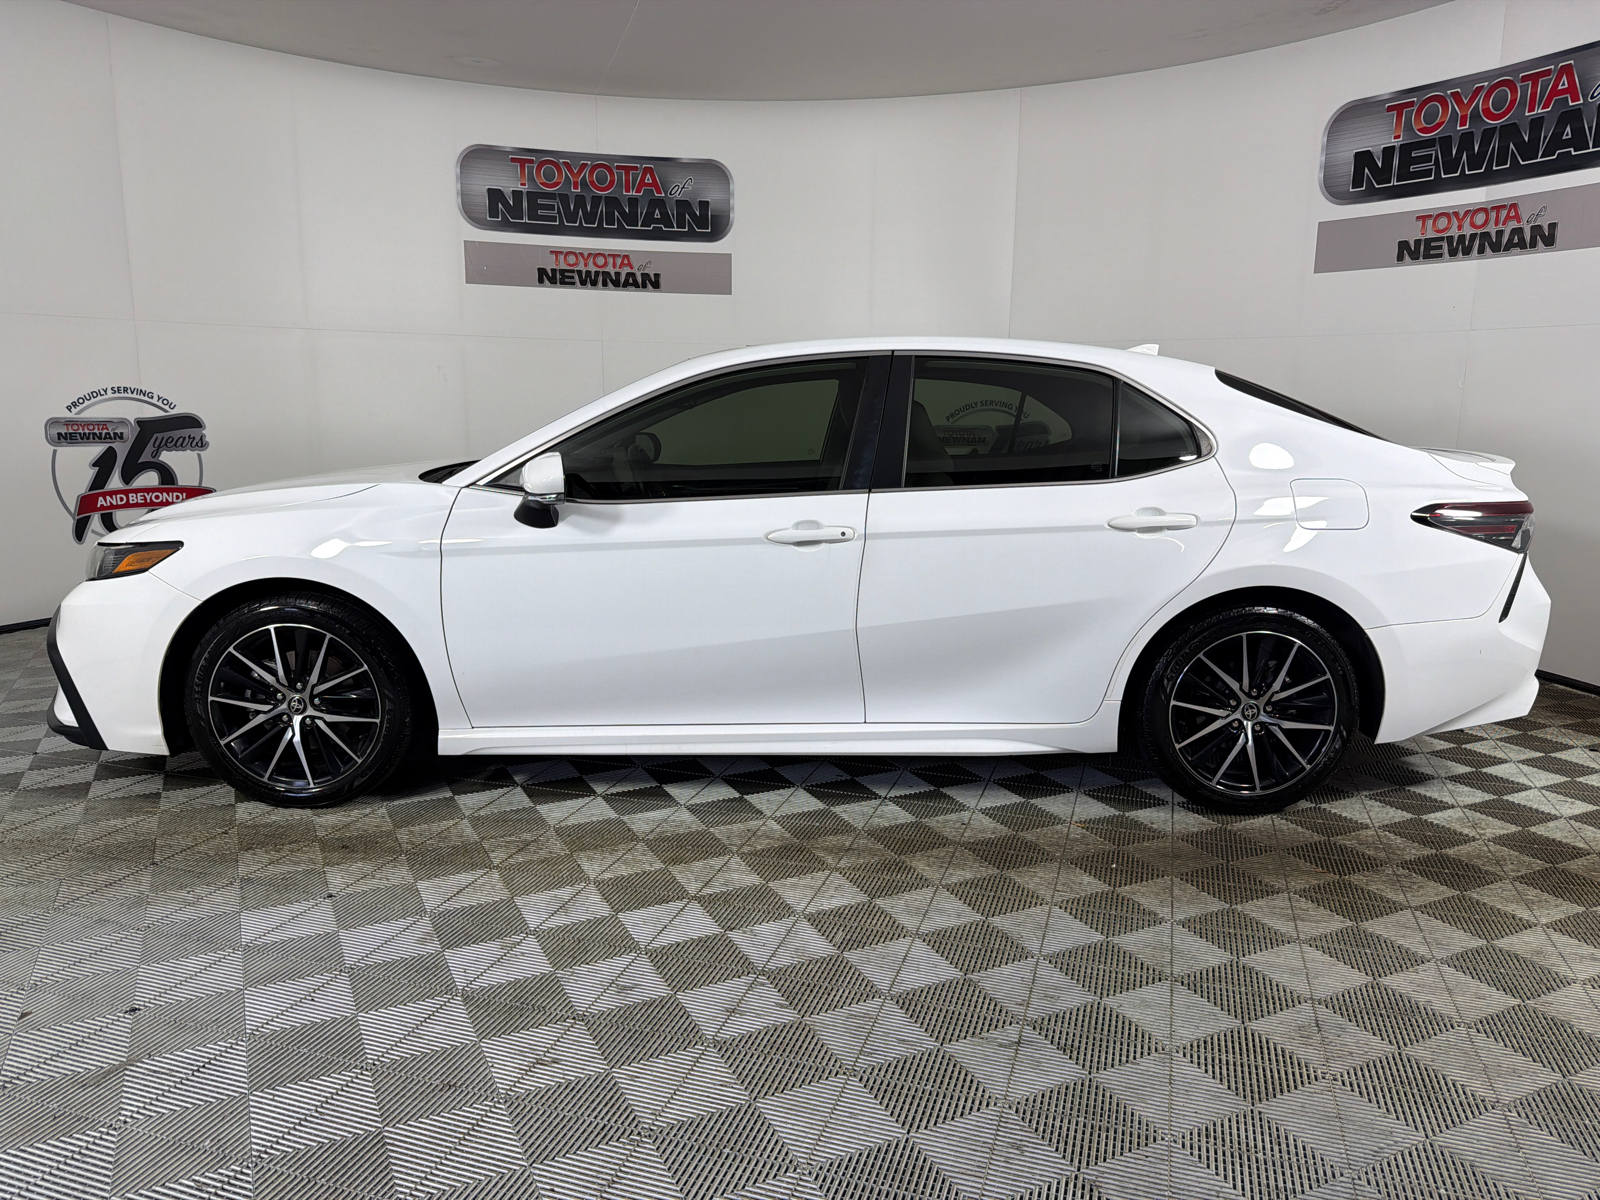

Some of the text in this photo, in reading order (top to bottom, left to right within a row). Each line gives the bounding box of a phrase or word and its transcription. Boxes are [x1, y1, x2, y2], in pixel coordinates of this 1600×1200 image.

[1386, 60, 1583, 141] TOYOTA
[509, 155, 693, 197] TOYOTA of
[486, 187, 711, 231] NEWNAN
[1416, 202, 1547, 236] TOYOTA of
[1396, 221, 1558, 264] NEWNAN
[550, 250, 652, 272] TOYOTA of
[537, 267, 661, 290] NEWNAN
[66, 386, 177, 413] PROUDLY SERVING YOU
[945, 399, 1031, 422] PROUDLY SERVING YU
[57, 431, 124, 441] NEWNAN
[63, 423, 109, 432] TOYOTA
[942, 429, 976, 437] TOYOTA
[151, 433, 208, 459] years
[97, 492, 187, 507] AND BEYOND!
